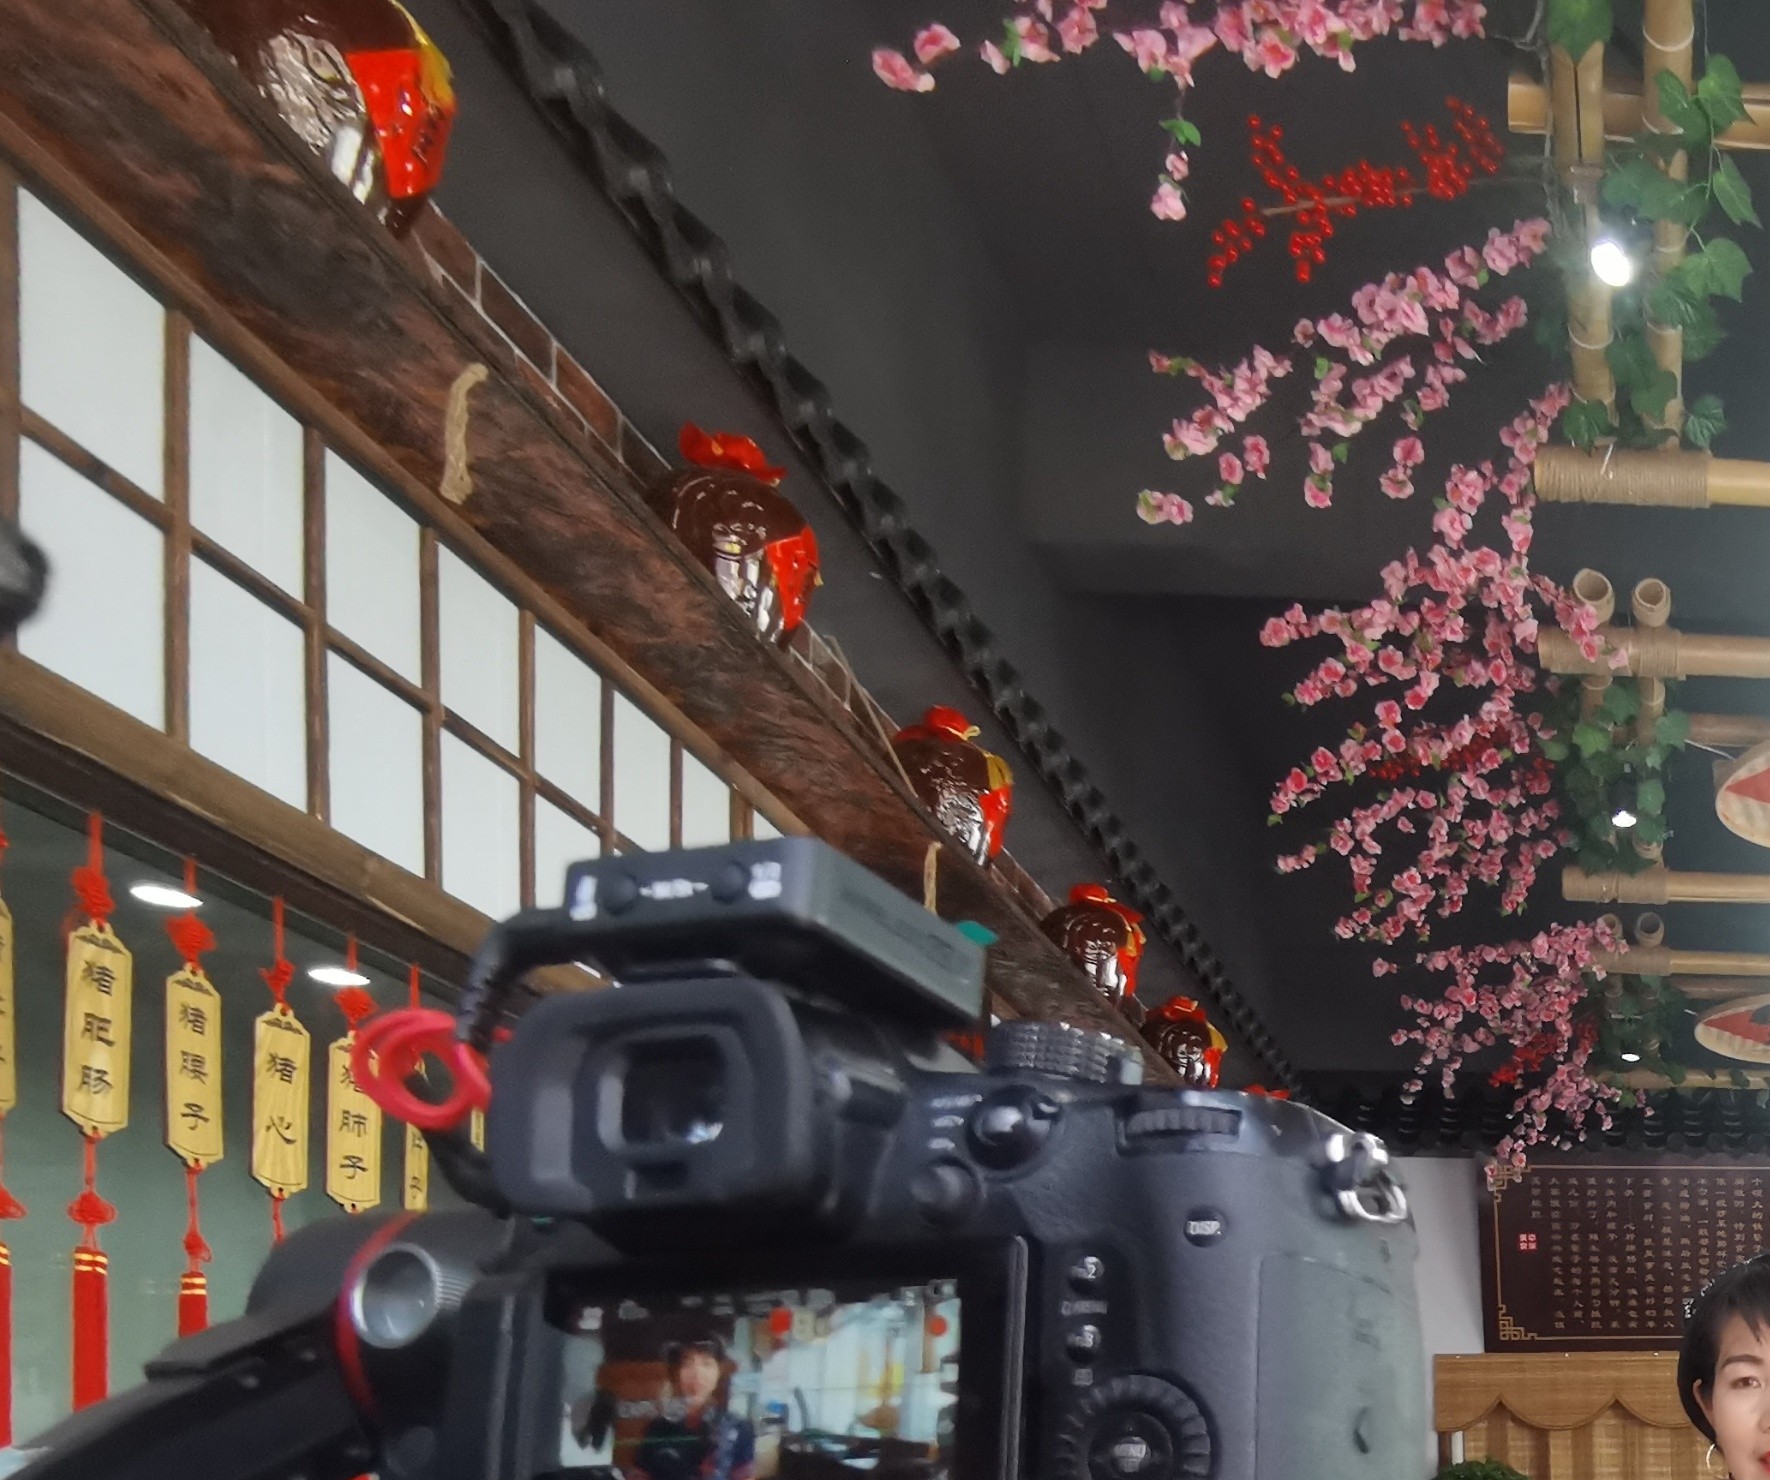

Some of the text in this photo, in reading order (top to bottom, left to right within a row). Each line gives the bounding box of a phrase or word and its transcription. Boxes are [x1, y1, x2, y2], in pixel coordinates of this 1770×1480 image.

[178, 1002, 210, 1131] 猪腰子
[265, 1051, 298, 1145] 猪心
